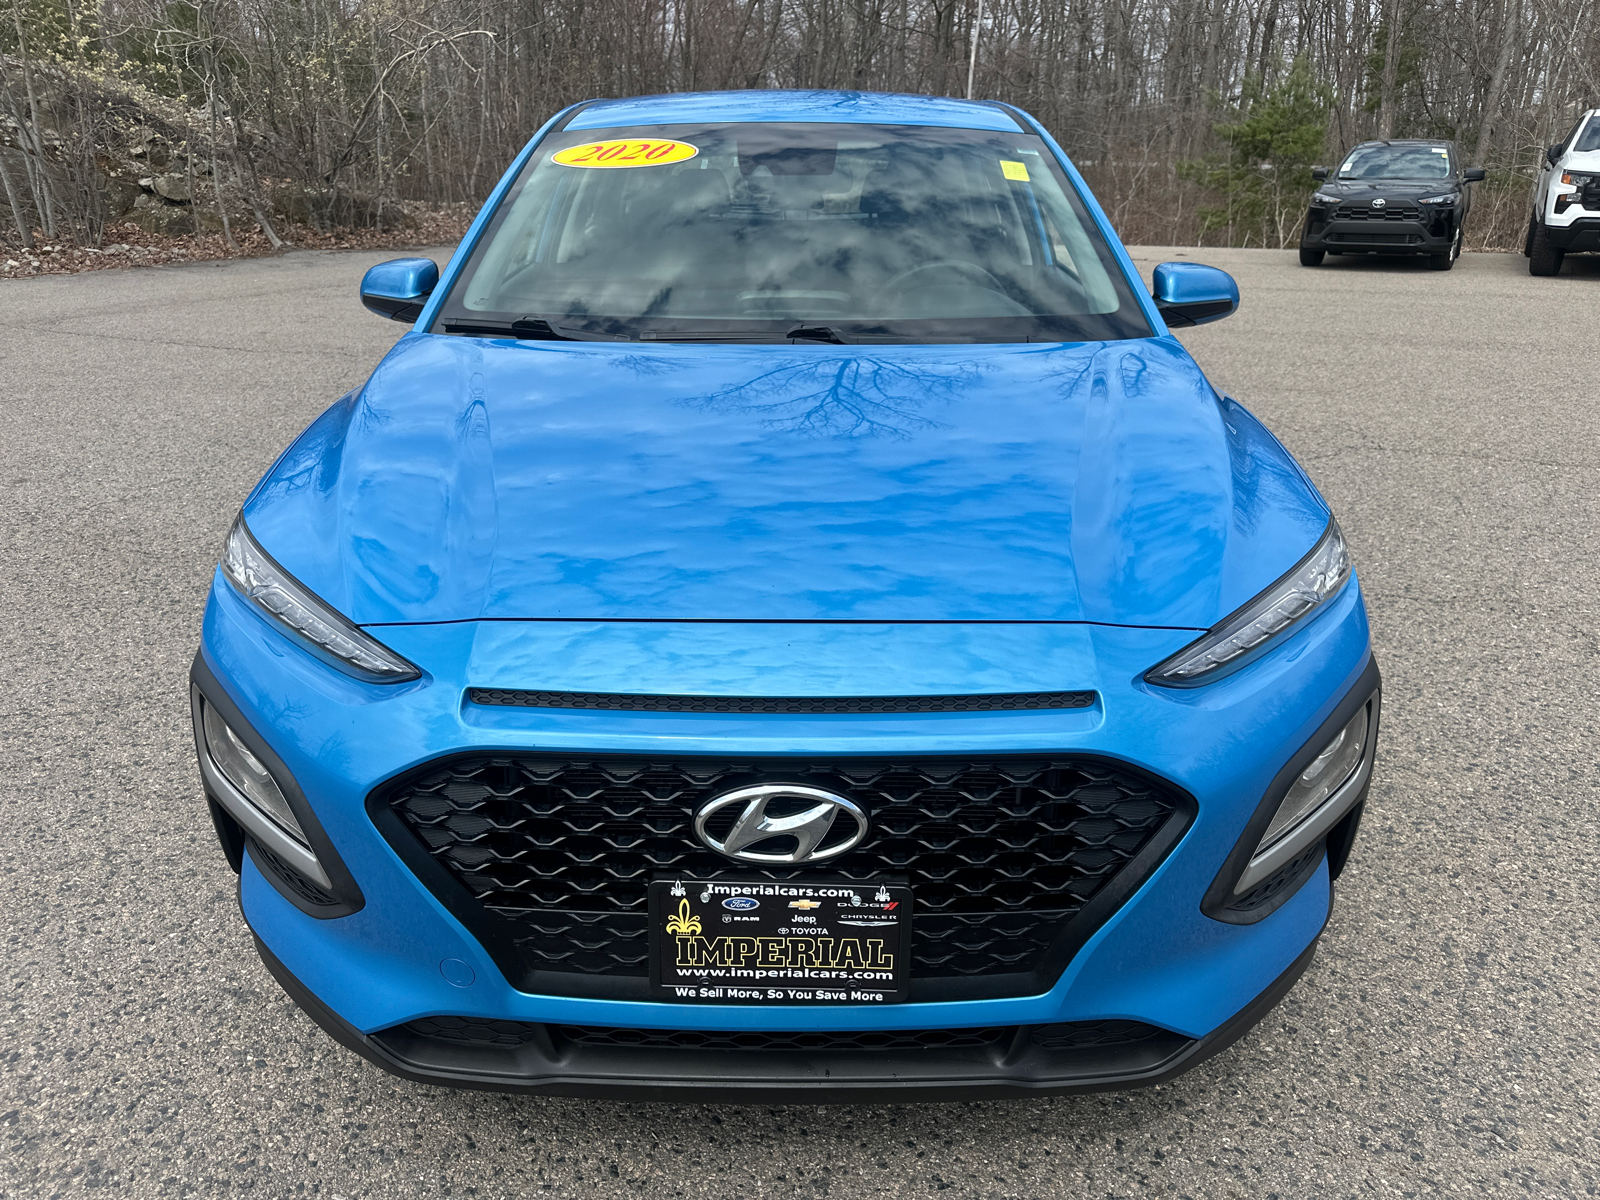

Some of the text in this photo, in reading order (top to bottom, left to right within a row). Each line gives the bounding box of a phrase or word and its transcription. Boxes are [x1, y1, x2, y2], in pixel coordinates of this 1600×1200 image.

[570, 143, 676, 162] 2020
[707, 884, 854, 897] Imperialcars.com
[730, 899, 752, 909] Ford
[791, 914, 816, 924] Jeep
[791, 927, 829, 935] TOYOTA
[675, 936, 894, 969] IMPERIAL
[676, 968, 893, 980] www.imperialcars.com
[675, 987, 884, 1001] We Sell More, So You Save More
